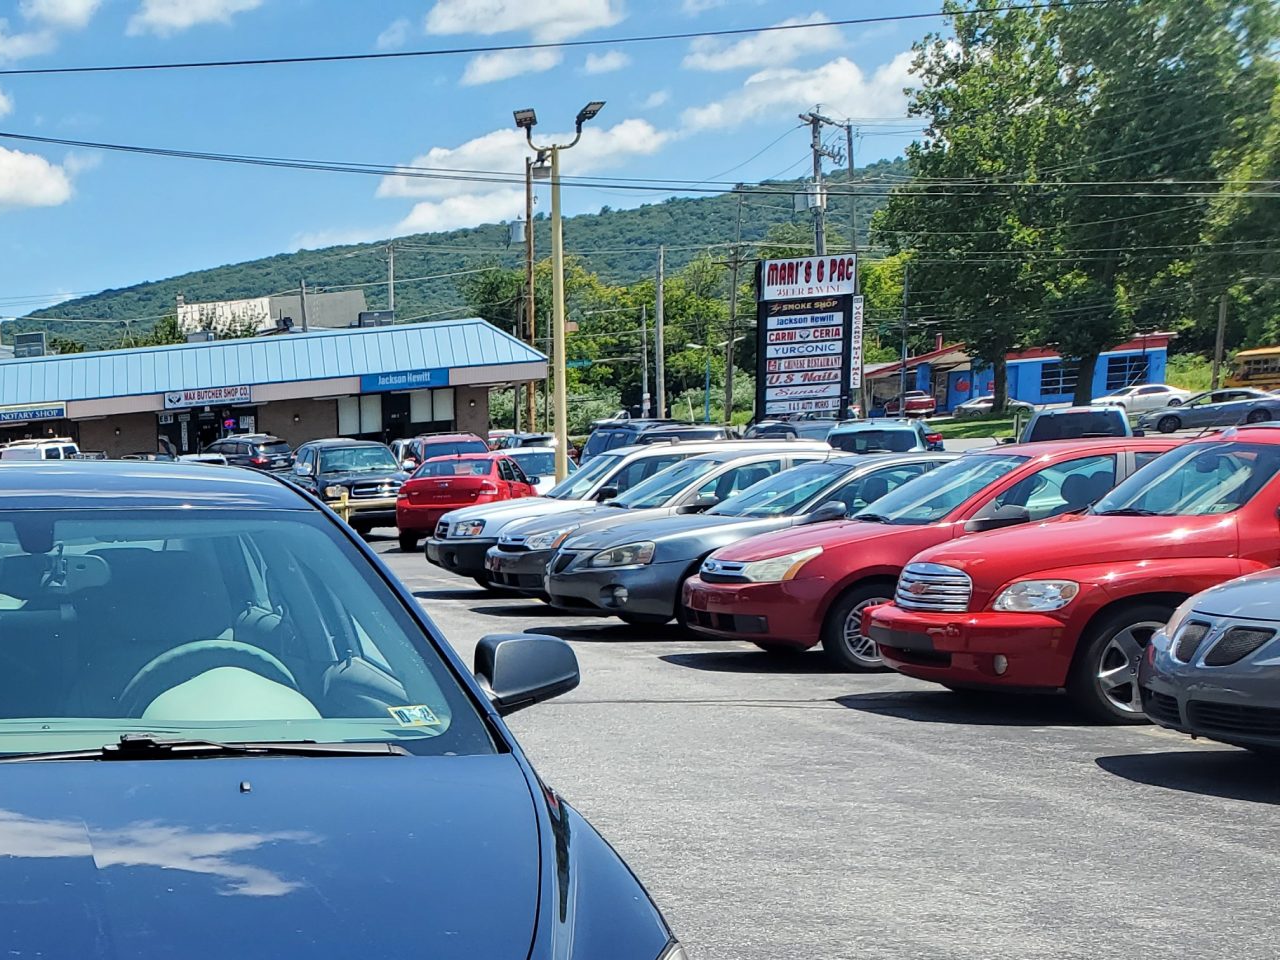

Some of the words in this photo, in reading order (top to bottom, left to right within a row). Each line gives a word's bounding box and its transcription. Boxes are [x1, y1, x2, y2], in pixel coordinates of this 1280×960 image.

[829, 257, 853, 282] PAC
[782, 302, 812, 311] SMOKE
[813, 300, 838, 309] SHOP
[776, 317, 808, 326] Jackson
[810, 314, 834, 323] Hewitt
[768, 331, 797, 342] CARNI
[812, 327, 841, 339] CERIA
[773, 343, 836, 355] YURCONIC
[783, 359, 806, 369] CHINESE
[806, 356, 841, 368] RESTAURANT
[378, 374, 407, 386] Jackson
[407, 371, 431, 383] Hewitt
[184, 391, 196, 401] MAX
[196, 388, 222, 400] BUTCHER
[223, 386, 239, 398] SHOP
[1, 411, 34, 421] NOTARY
[35, 409, 58, 418] SHOP
